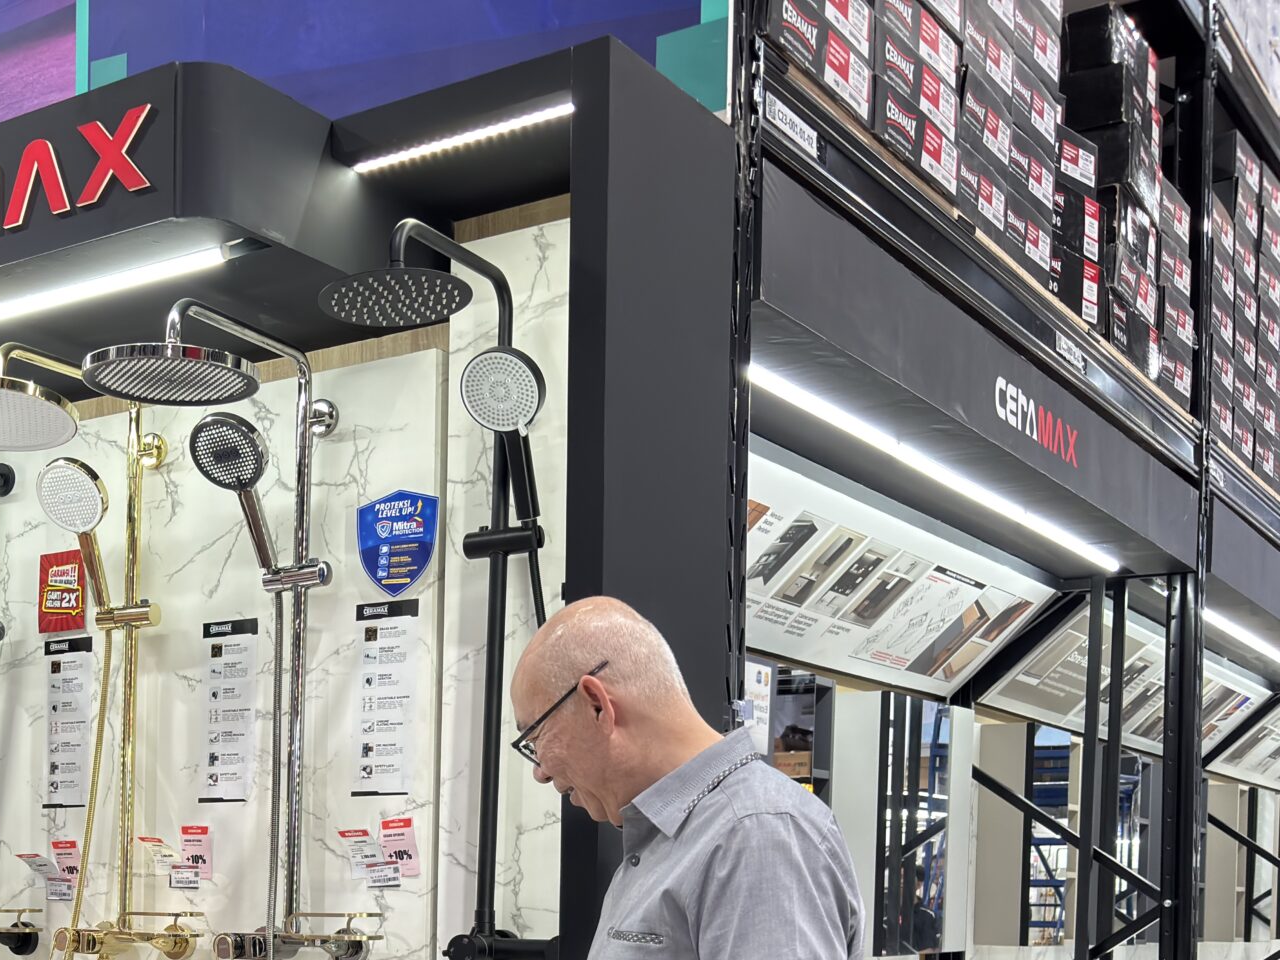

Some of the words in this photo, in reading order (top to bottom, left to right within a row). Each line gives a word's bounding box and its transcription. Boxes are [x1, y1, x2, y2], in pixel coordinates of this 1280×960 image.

[782, 2, 818, 50] CERAMAX
[885, 40, 915, 84] CERAMAX
[886, 98, 917, 140] CERAMAX
[995, 376, 1079, 469] CERAMAX
[374, 499, 411, 512] PROTEKSI
[378, 508, 400, 518] LEVEL
[402, 506, 415, 516] UP!
[392, 520, 417, 531] Mitra
[392, 527, 424, 536] PROTECTION
[186, 854, 207, 865] +10%
[388, 849, 413, 861] +10%
